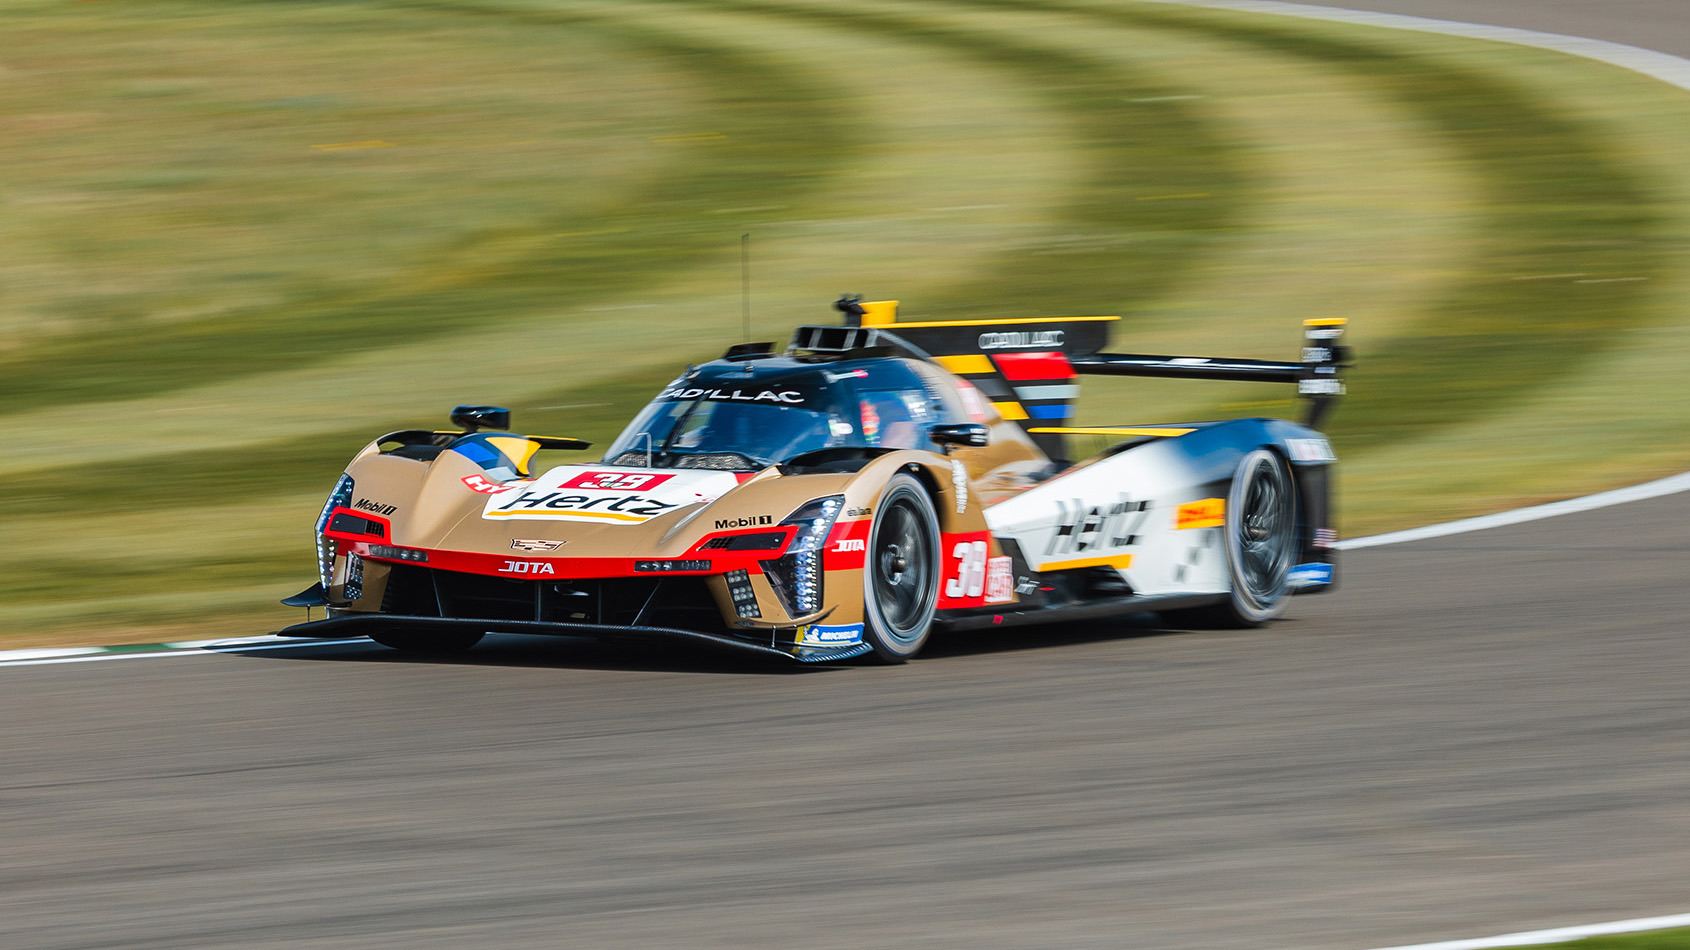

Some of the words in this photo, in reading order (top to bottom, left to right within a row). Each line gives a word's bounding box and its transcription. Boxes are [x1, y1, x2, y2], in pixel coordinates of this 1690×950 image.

[354, 498, 387, 513] Mobil
[498, 491, 680, 516] Hertz
[715, 516, 756, 529] Mobil
[759, 515, 772, 525] 1
[831, 539, 865, 552] JOTA
[498, 560, 555, 574] JOTA
